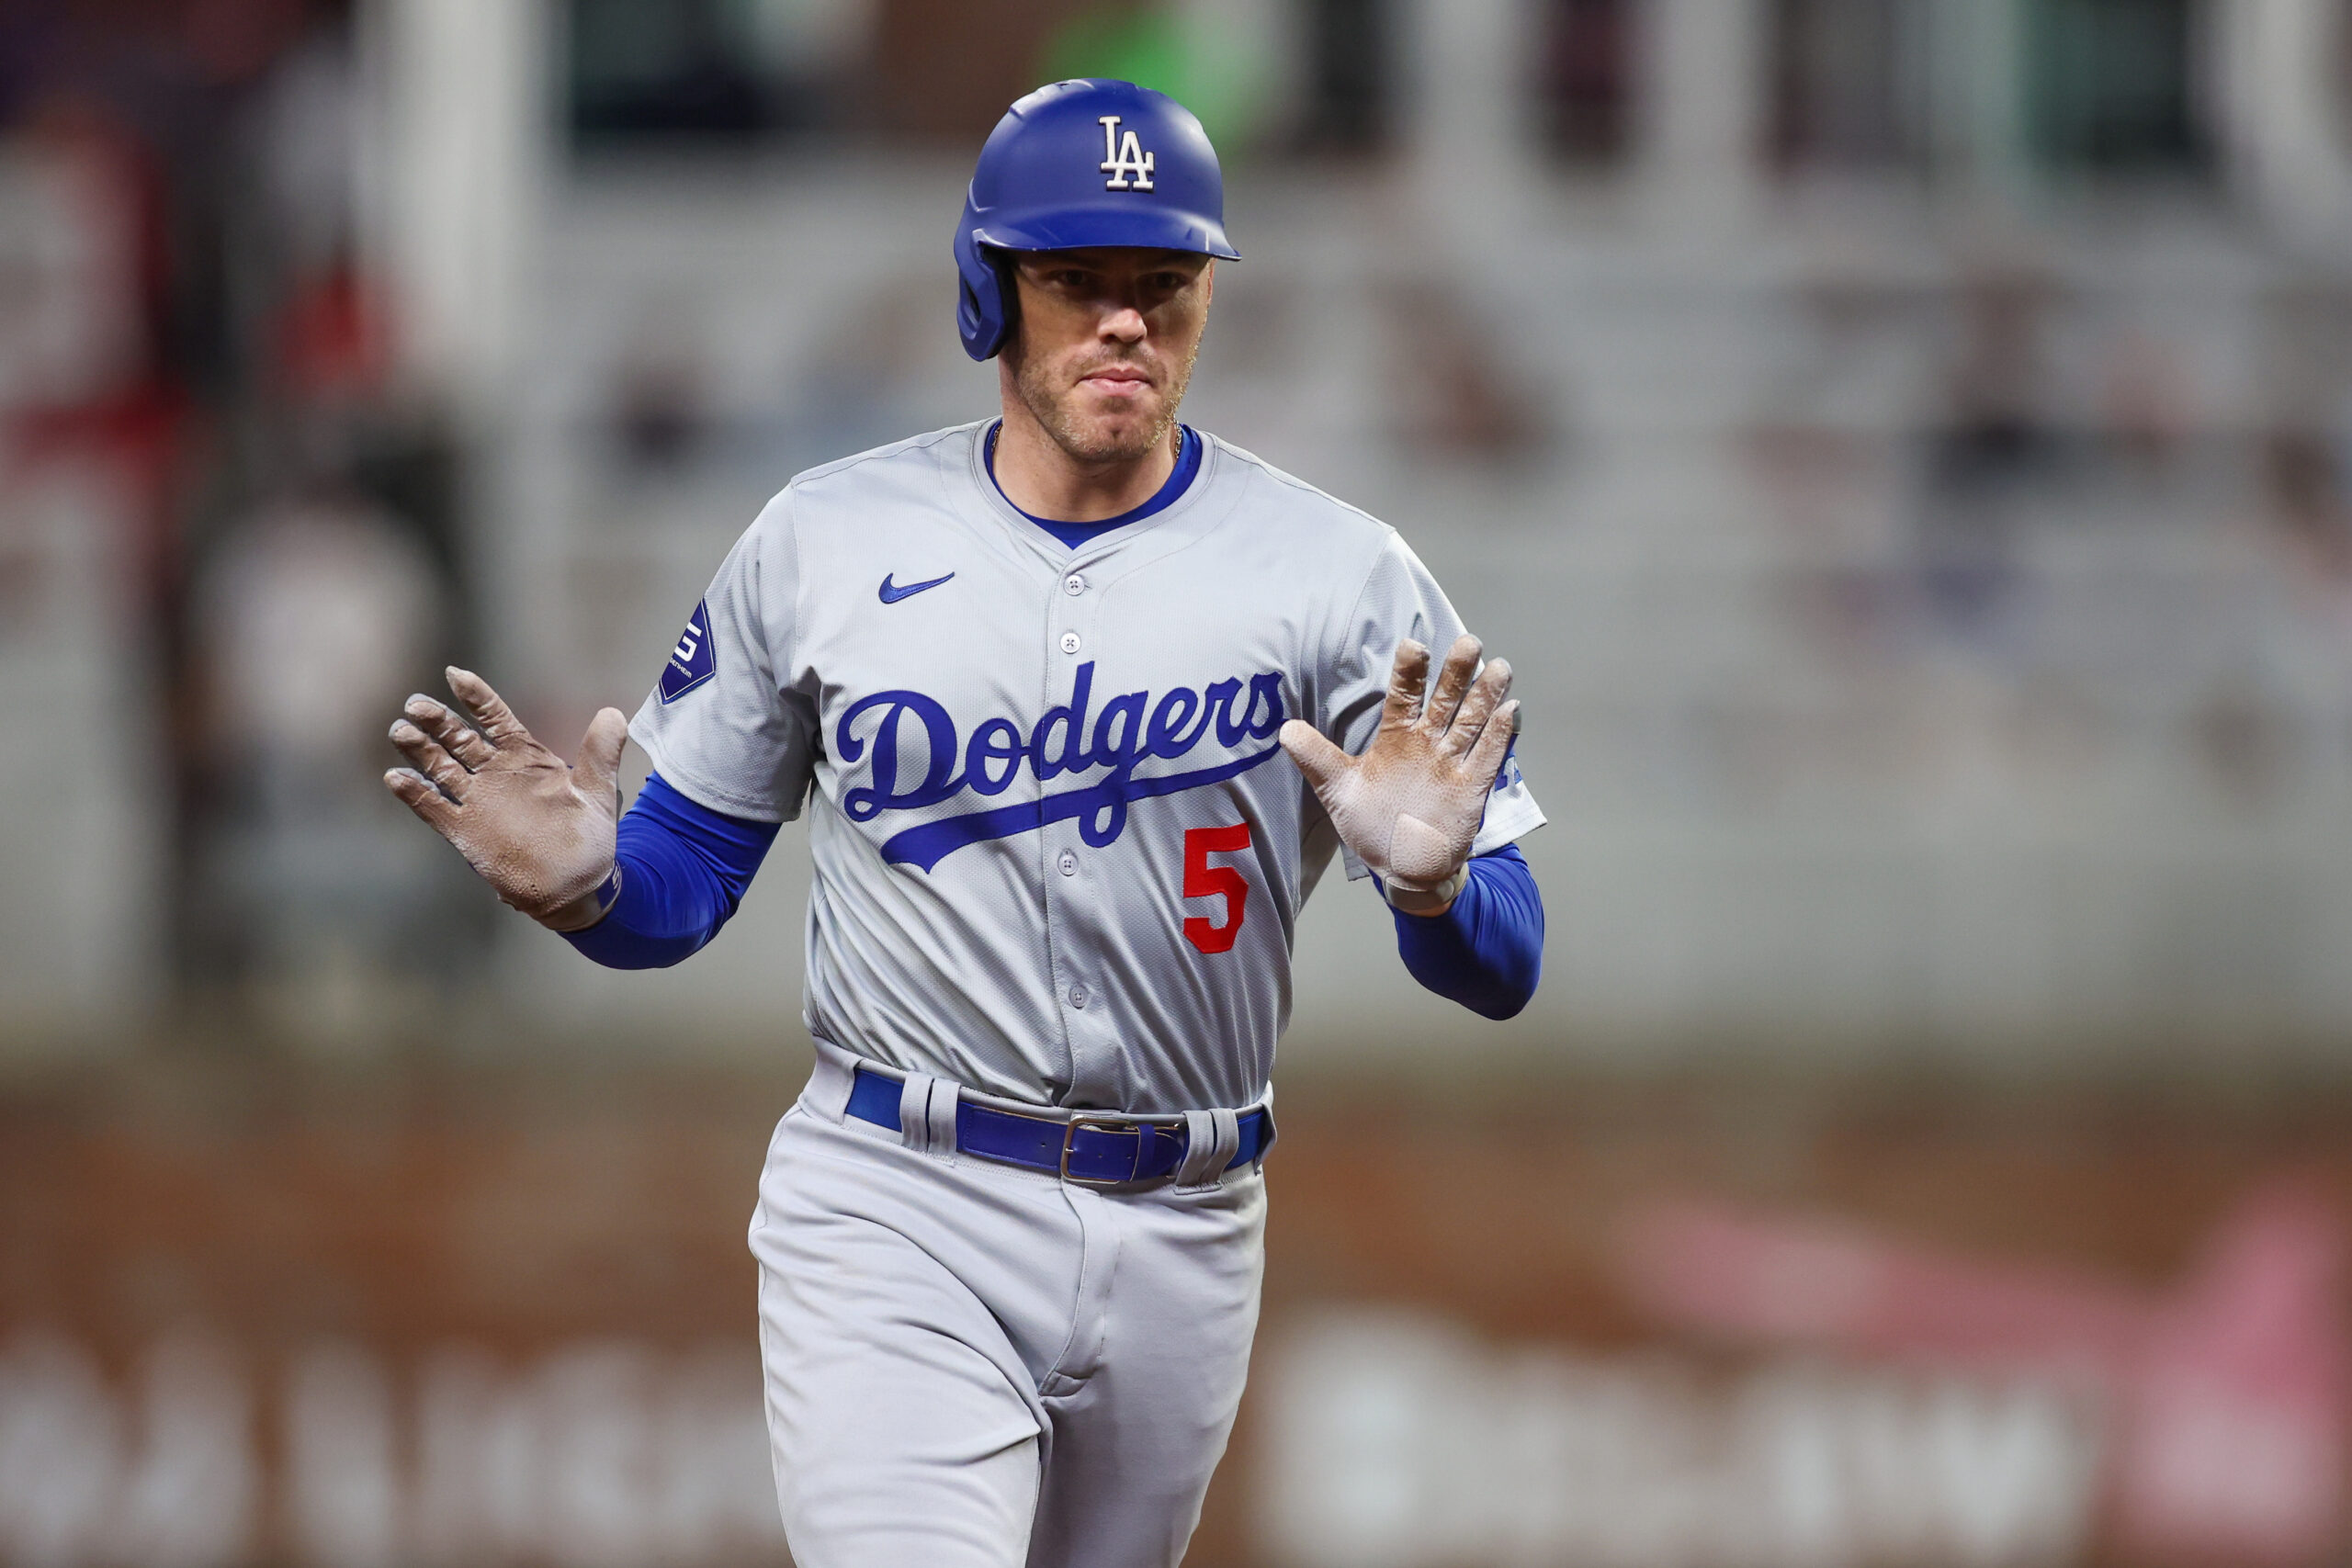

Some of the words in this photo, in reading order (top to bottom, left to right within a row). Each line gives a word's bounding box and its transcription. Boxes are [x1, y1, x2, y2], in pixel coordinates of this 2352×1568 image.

[1099, 116, 1154, 192] LA
[837, 661, 1288, 847] Dodgers
[1183, 822, 1250, 953] 5
